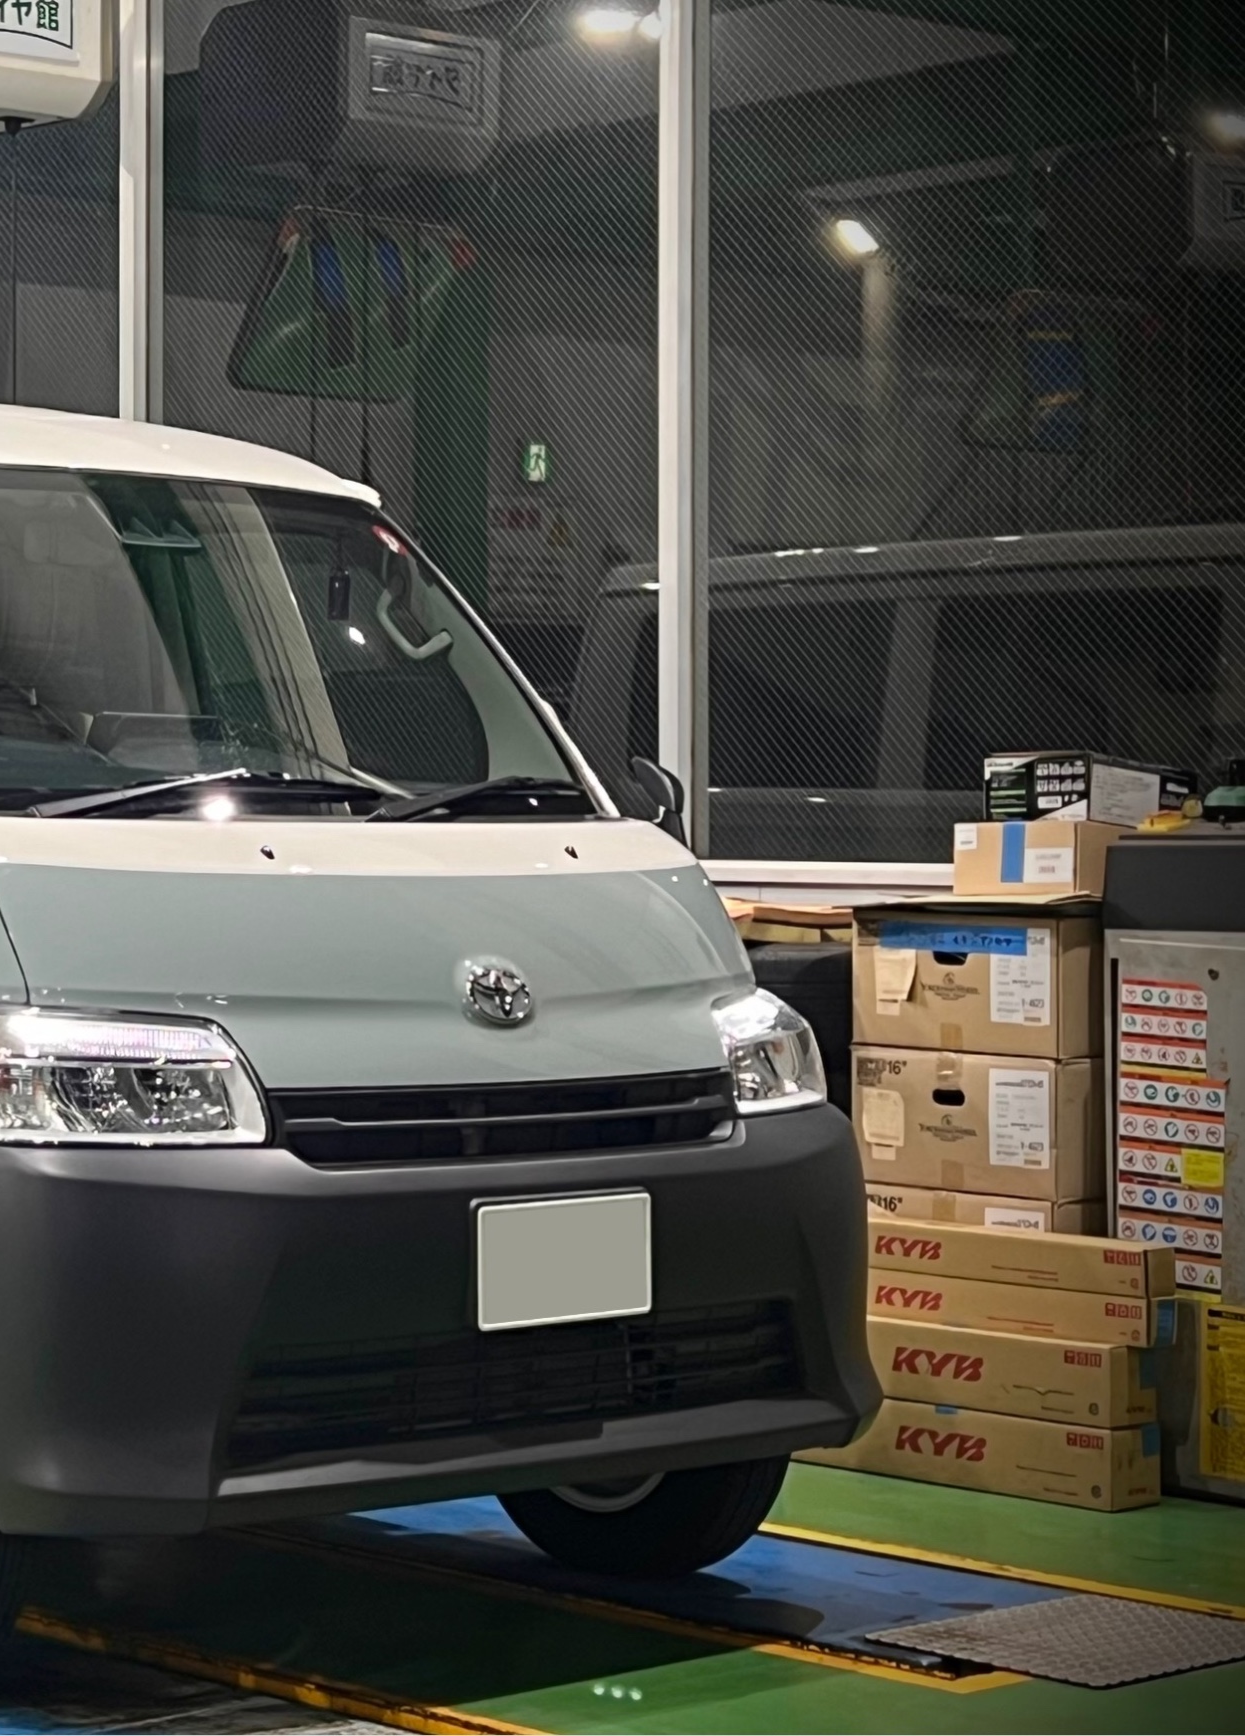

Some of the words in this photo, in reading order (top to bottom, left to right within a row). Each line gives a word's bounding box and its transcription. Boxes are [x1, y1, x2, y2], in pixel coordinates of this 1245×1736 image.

[874, 1235, 943, 1261] KYB
[874, 1285, 944, 1312] KYB
[891, 1346, 985, 1383] KYB
[894, 1425, 988, 1463] KYB
